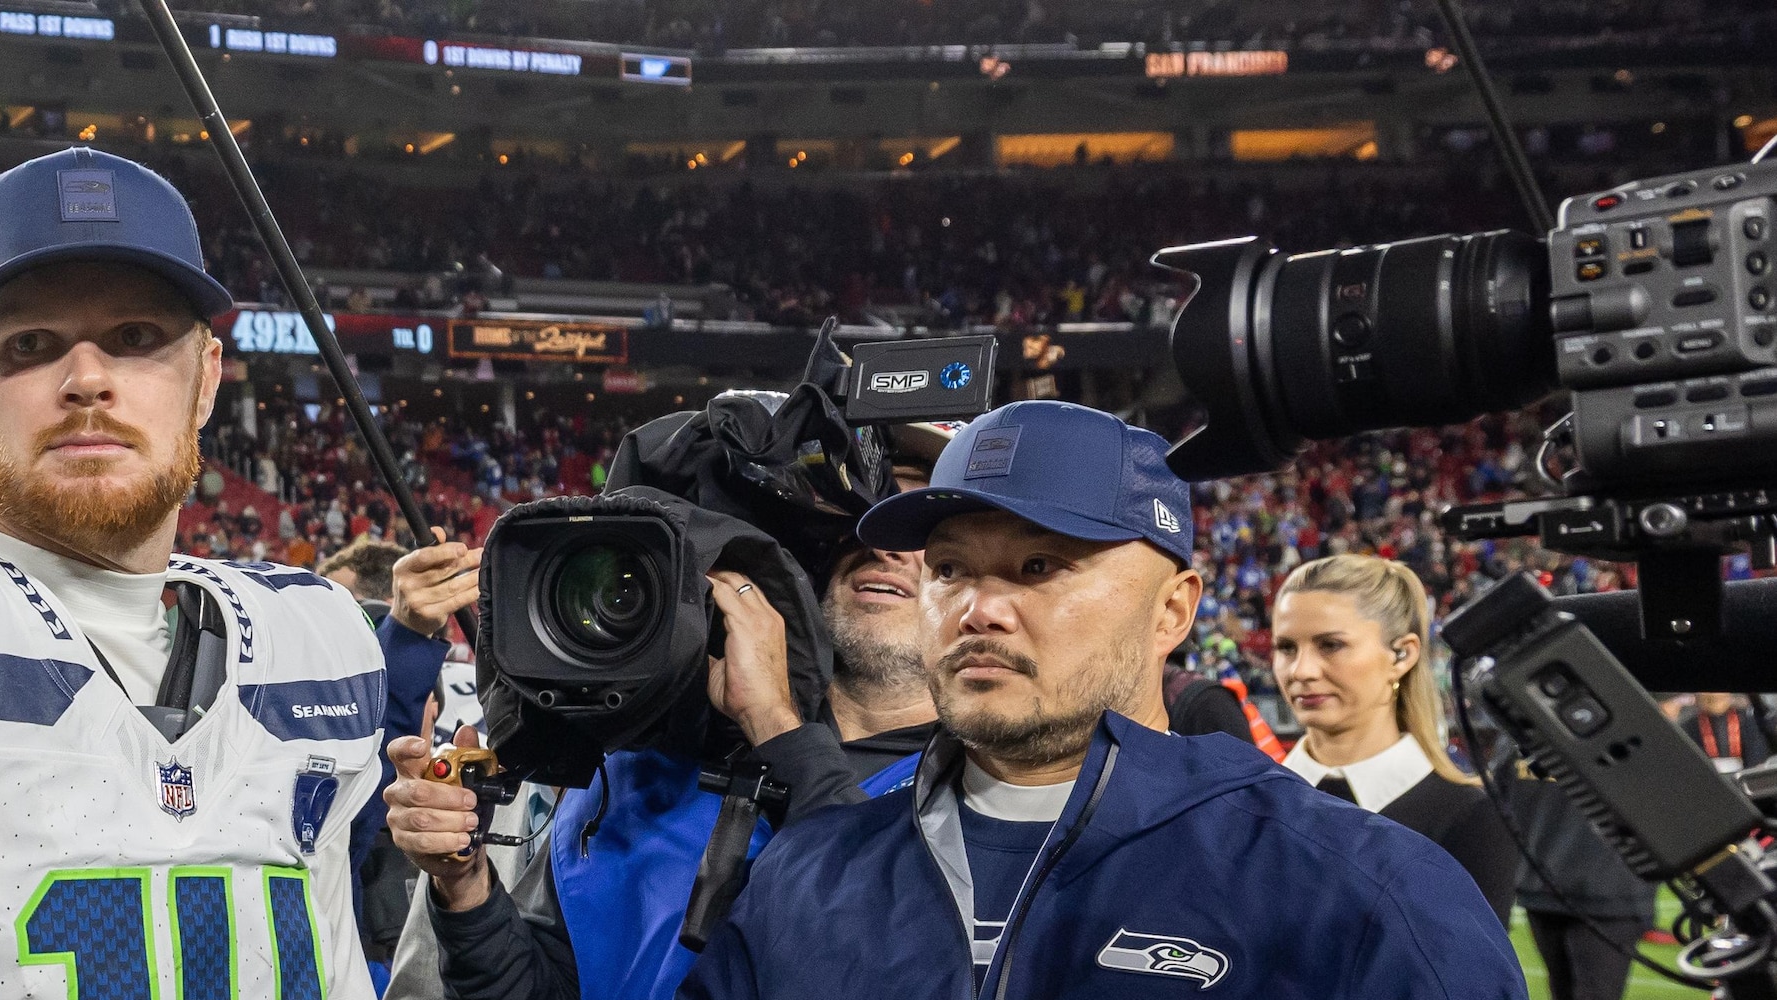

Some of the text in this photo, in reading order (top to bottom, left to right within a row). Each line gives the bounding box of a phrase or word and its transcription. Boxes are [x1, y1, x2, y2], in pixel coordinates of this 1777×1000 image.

[232, 310, 335, 353] 49ER
[416, 323, 433, 354] 0
[876, 375, 924, 388] SMP
[291, 702, 359, 719] SEAHAWKS
[164, 784, 192, 807] NFL
